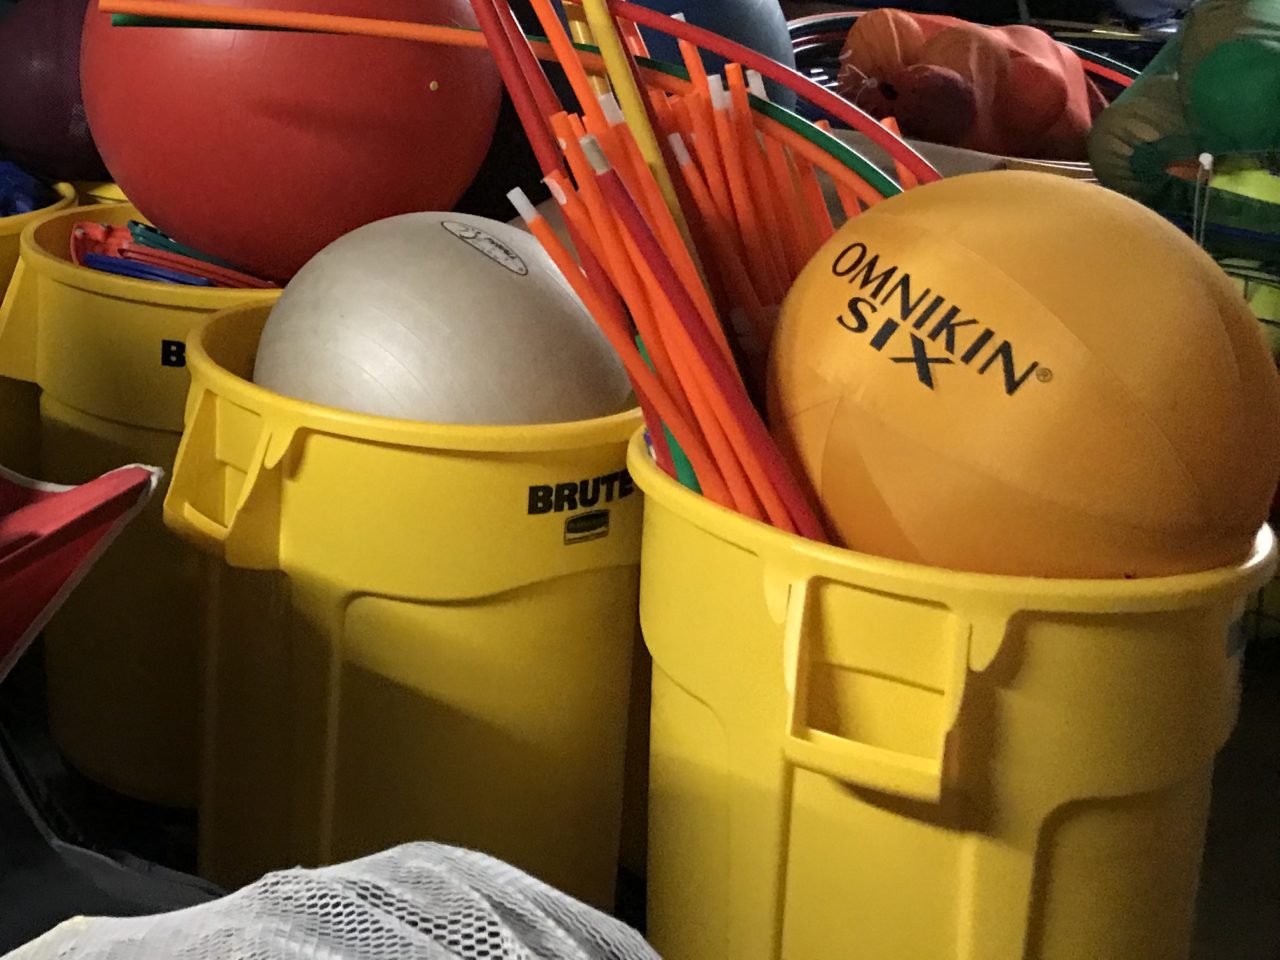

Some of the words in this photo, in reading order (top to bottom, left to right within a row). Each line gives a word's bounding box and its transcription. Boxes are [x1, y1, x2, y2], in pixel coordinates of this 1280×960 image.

[831, 242, 1039, 396] OMNIKIN
[835, 296, 956, 391] SIX
[527, 468, 635, 515] BRUTE
